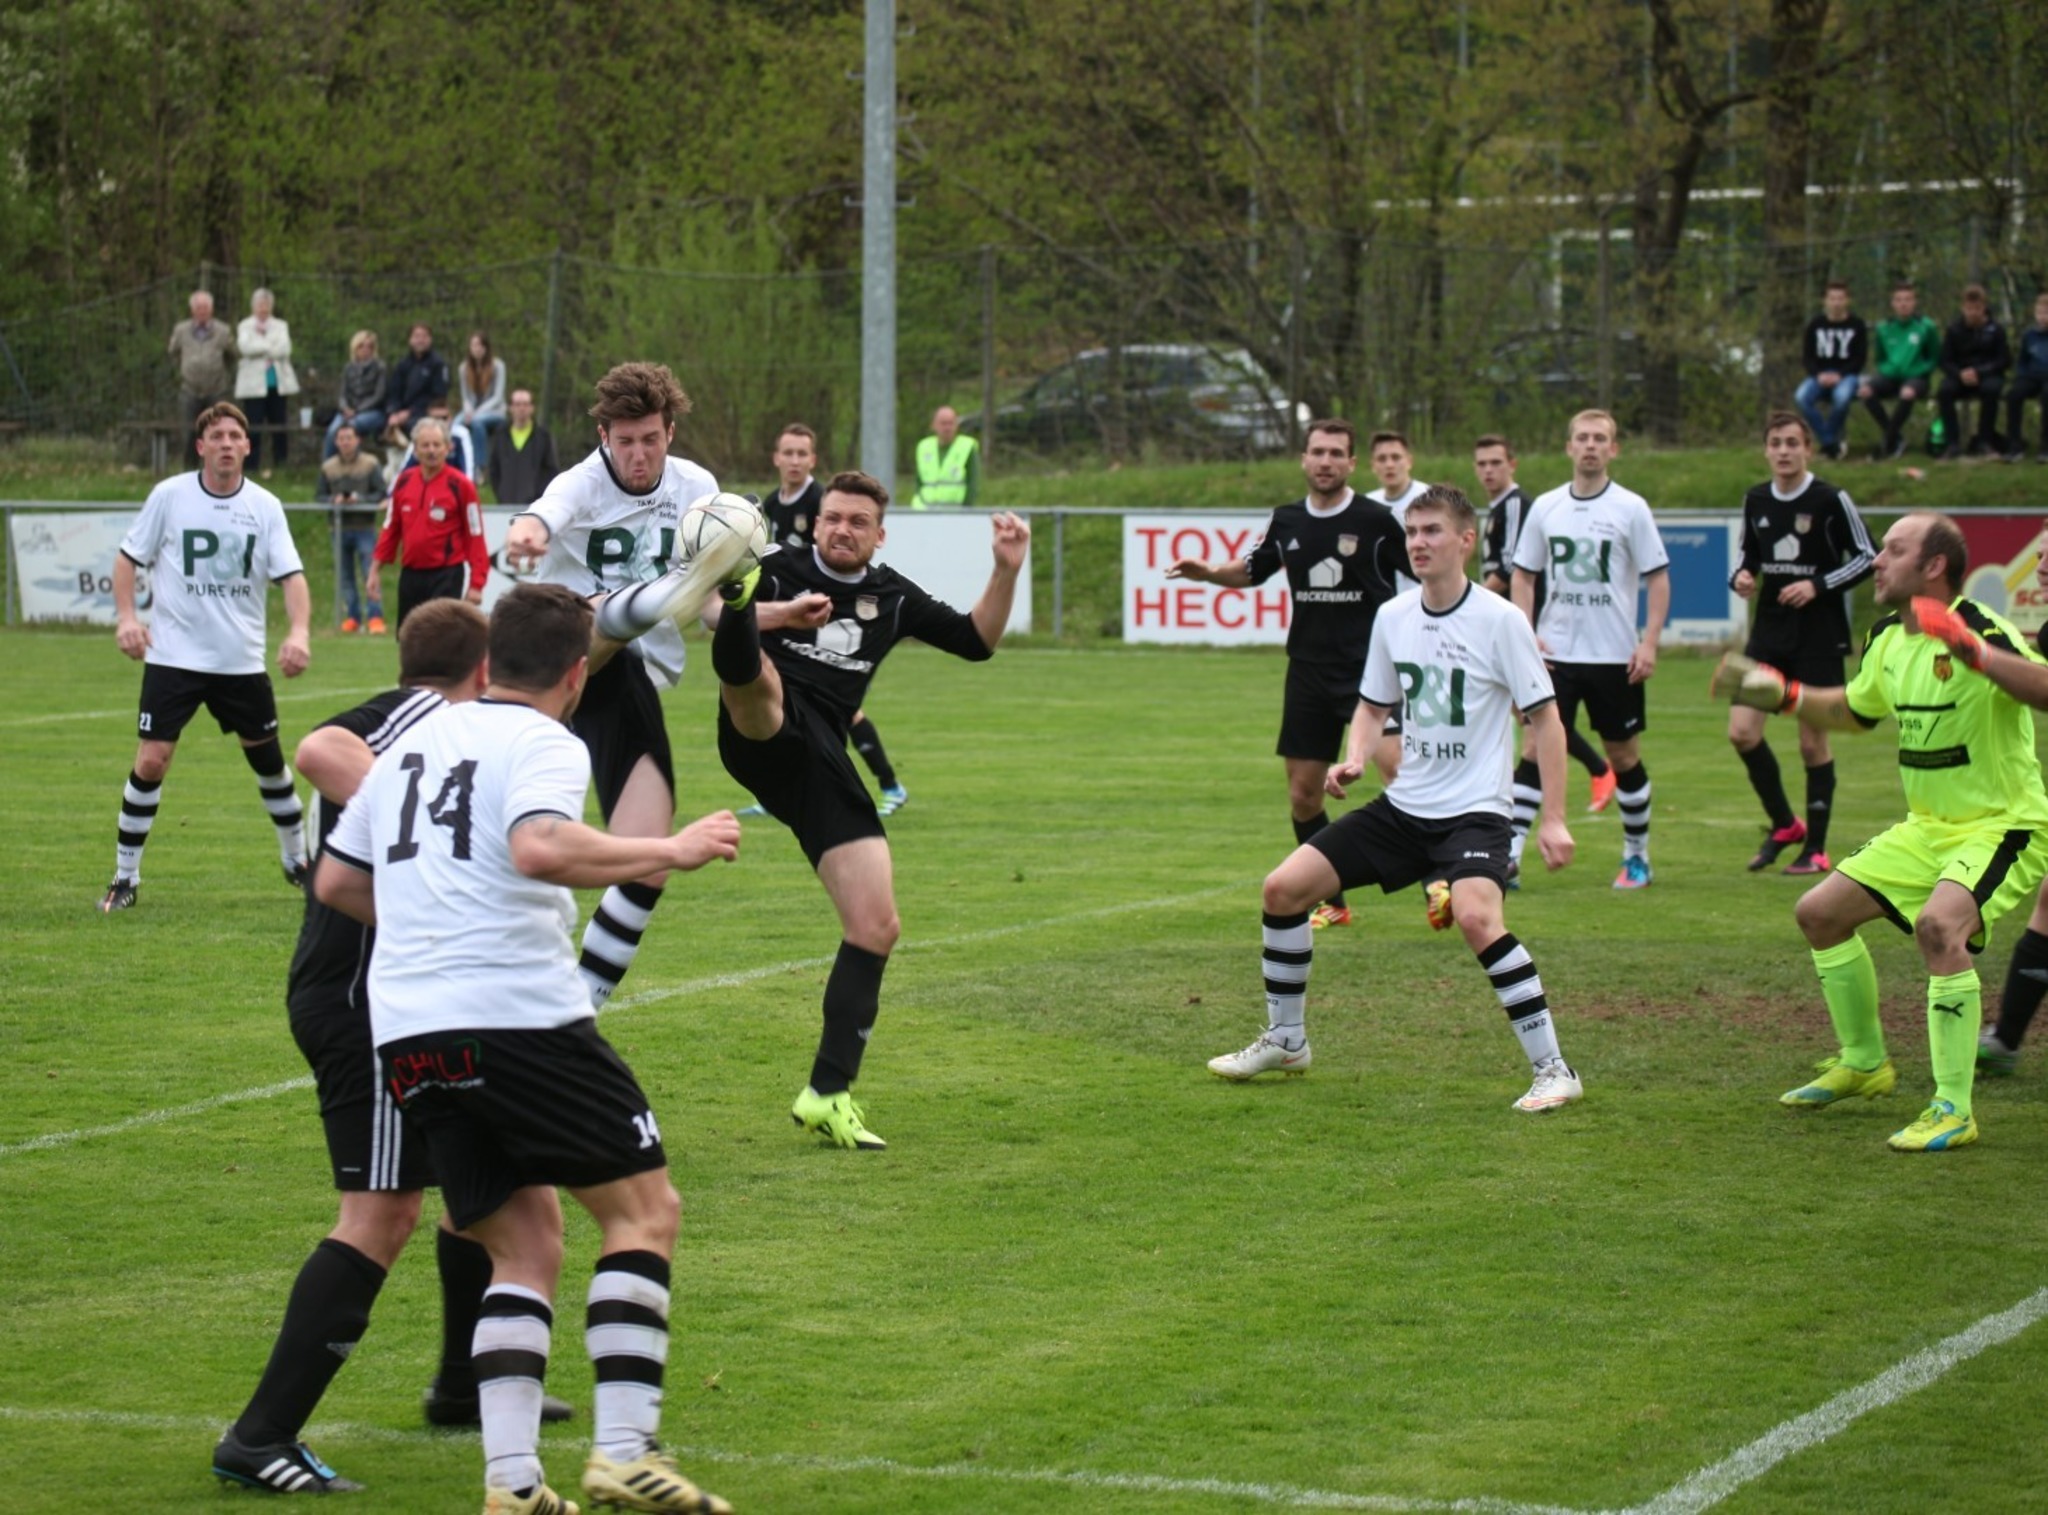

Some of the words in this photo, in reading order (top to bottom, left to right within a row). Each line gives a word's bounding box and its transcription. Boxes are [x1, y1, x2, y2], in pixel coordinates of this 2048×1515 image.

[1815, 328, 1855, 359] NY
[183, 529, 256, 580] P&I
[1135, 528, 1265, 569] TOY
[1549, 536, 1612, 584] P&I
[187, 584, 226, 597] PURE
[231, 585, 252, 597] HR
[1589, 593, 1612, 606] HR
[1393, 662, 1466, 728] P&I
[139, 711, 152, 731] 21
[1436, 742, 1467, 760] HR
[387, 753, 479, 864] 14
[632, 1110, 661, 1149] 14
